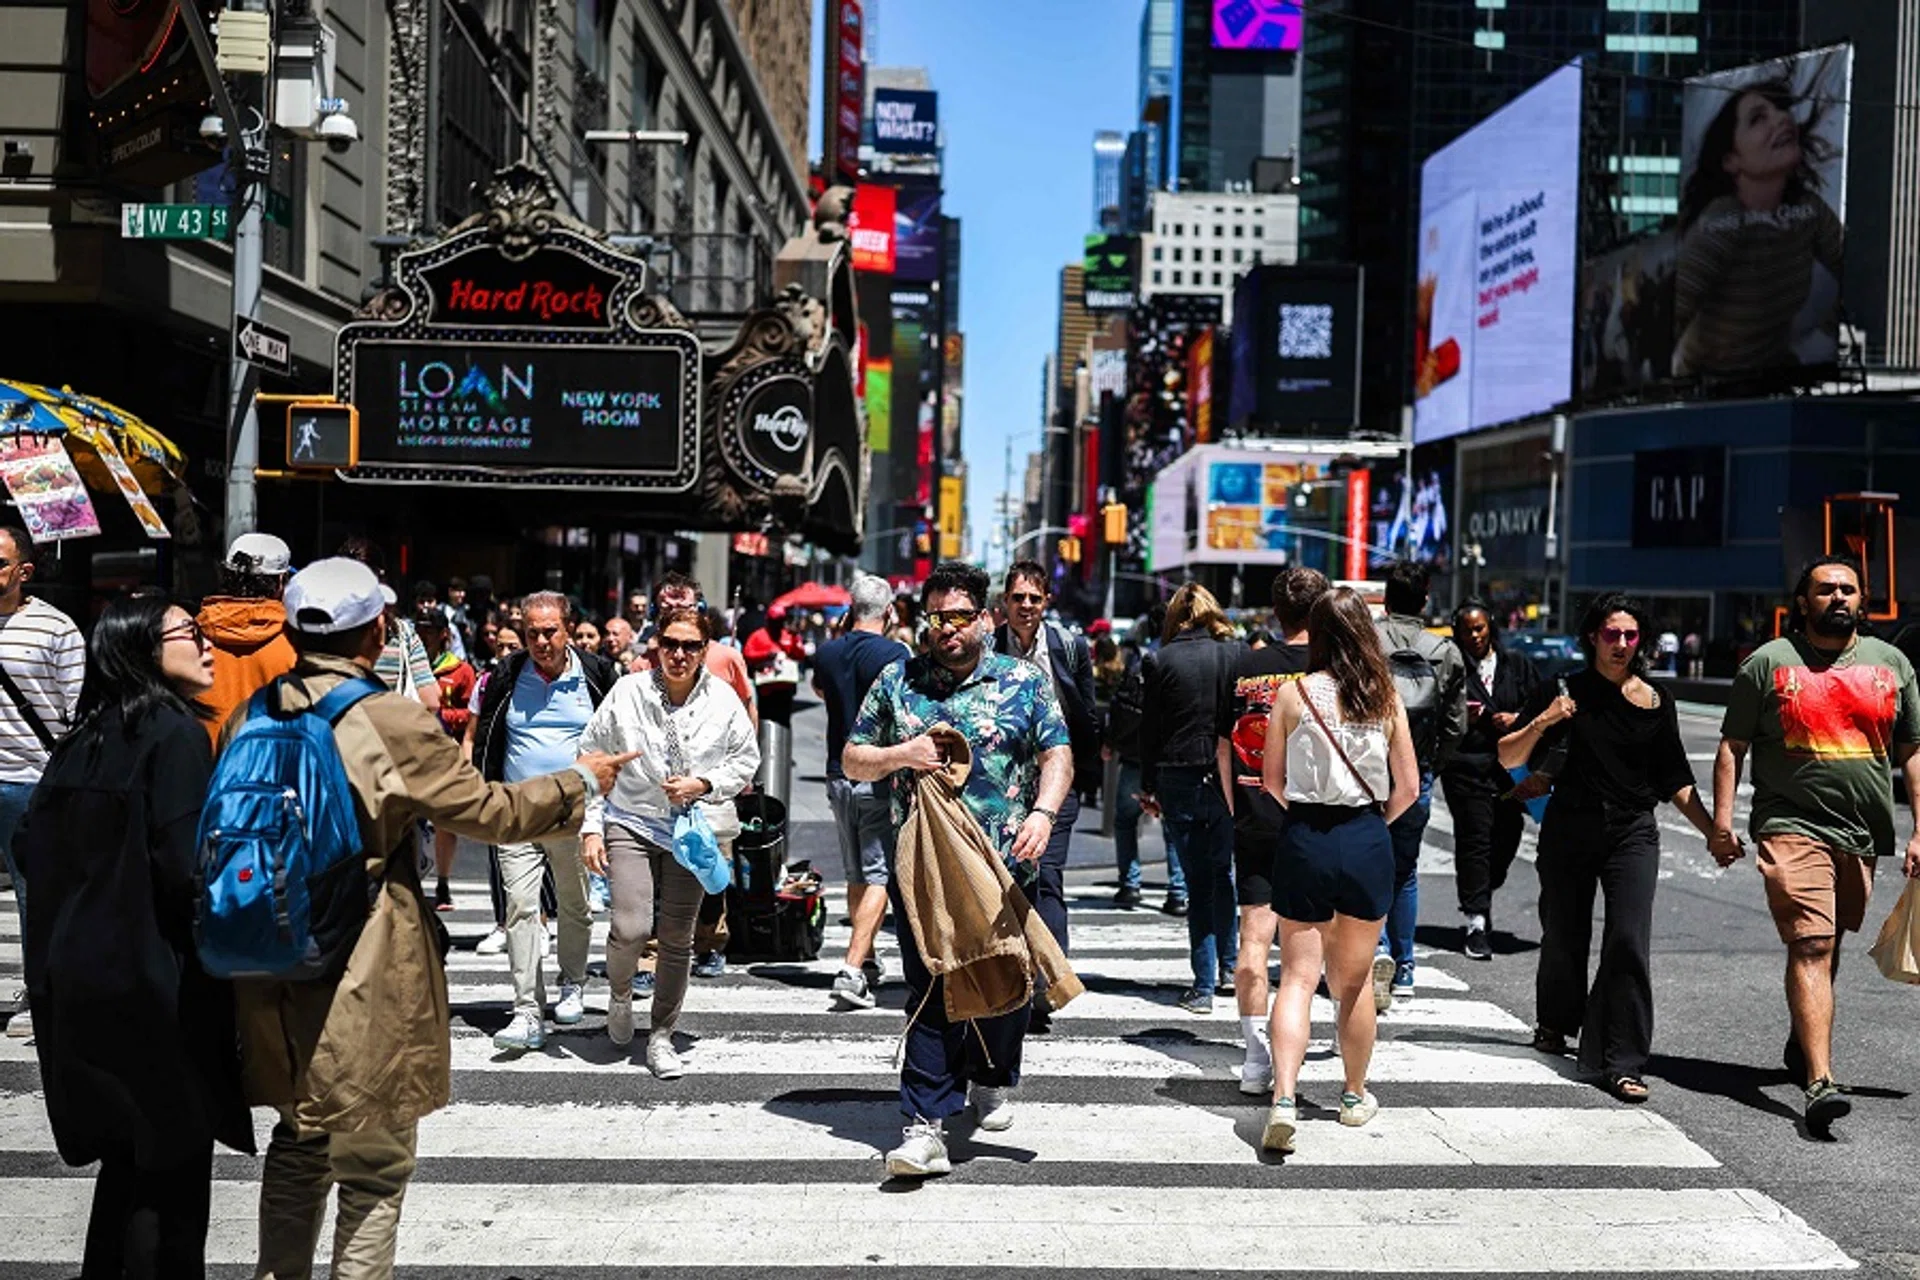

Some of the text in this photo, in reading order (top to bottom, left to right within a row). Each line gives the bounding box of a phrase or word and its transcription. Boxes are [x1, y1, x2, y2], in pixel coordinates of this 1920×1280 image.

[876, 101, 916, 120] NOW
[877, 121, 935, 141] WHAT?
[149, 208, 228, 234] W 43 St
[449, 278, 603, 321] Hard Rock
[399, 400, 478, 413] STREAM
[561, 390, 662, 409] NEW YORK
[399, 415, 532, 434] MORTGAGE
[582, 408, 641, 427] ROOM
[1650, 474, 1706, 522] GAP
[1469, 506, 1542, 538] OLD NAVY
